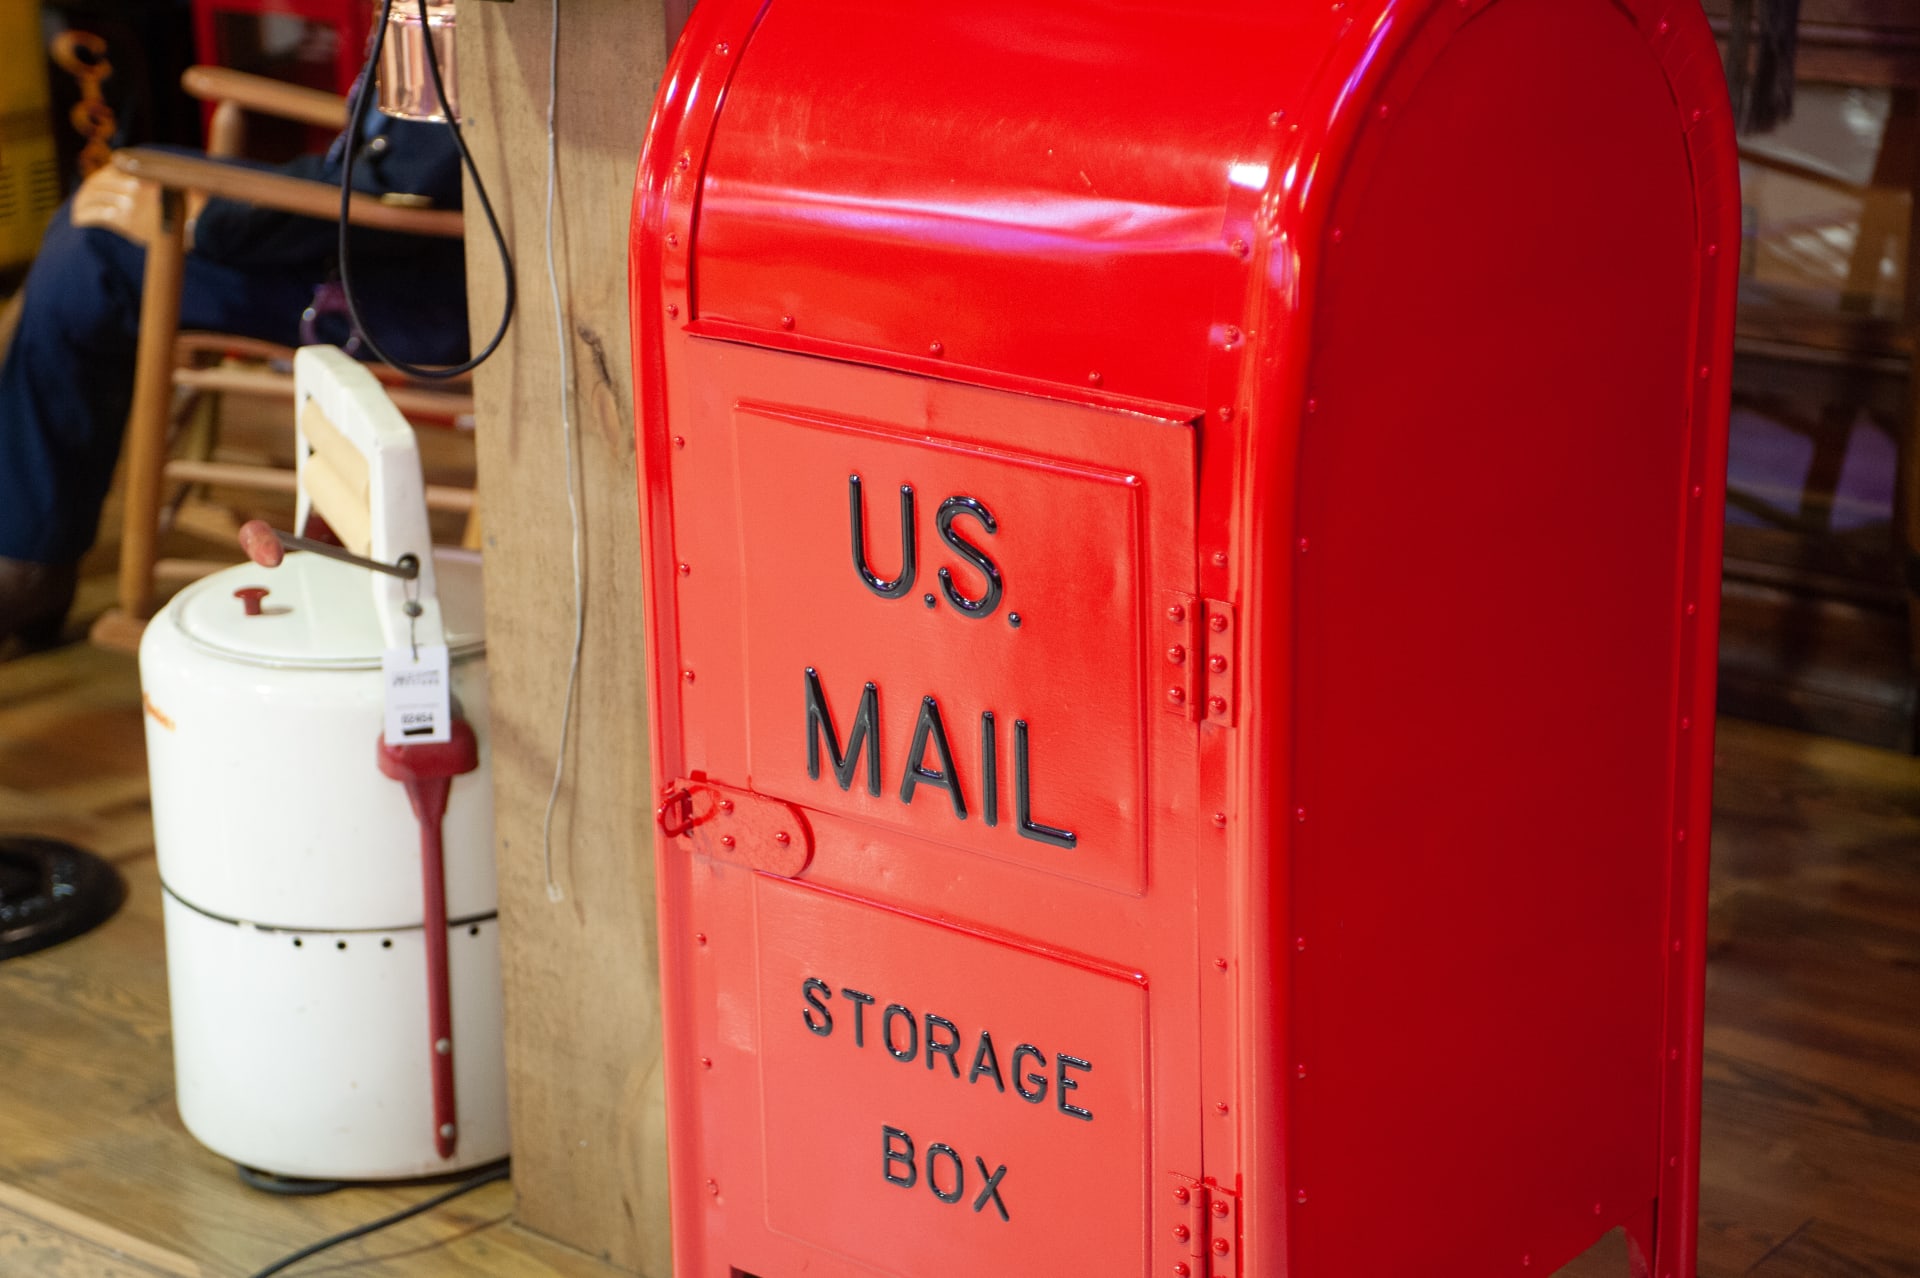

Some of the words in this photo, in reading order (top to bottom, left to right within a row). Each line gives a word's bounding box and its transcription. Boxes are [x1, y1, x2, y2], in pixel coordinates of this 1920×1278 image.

[849, 474, 1022, 628] U.S.
[804, 668, 1078, 850] MAIL
[802, 977, 1093, 1122] STORAGE
[882, 1125, 1011, 1222] BOX
